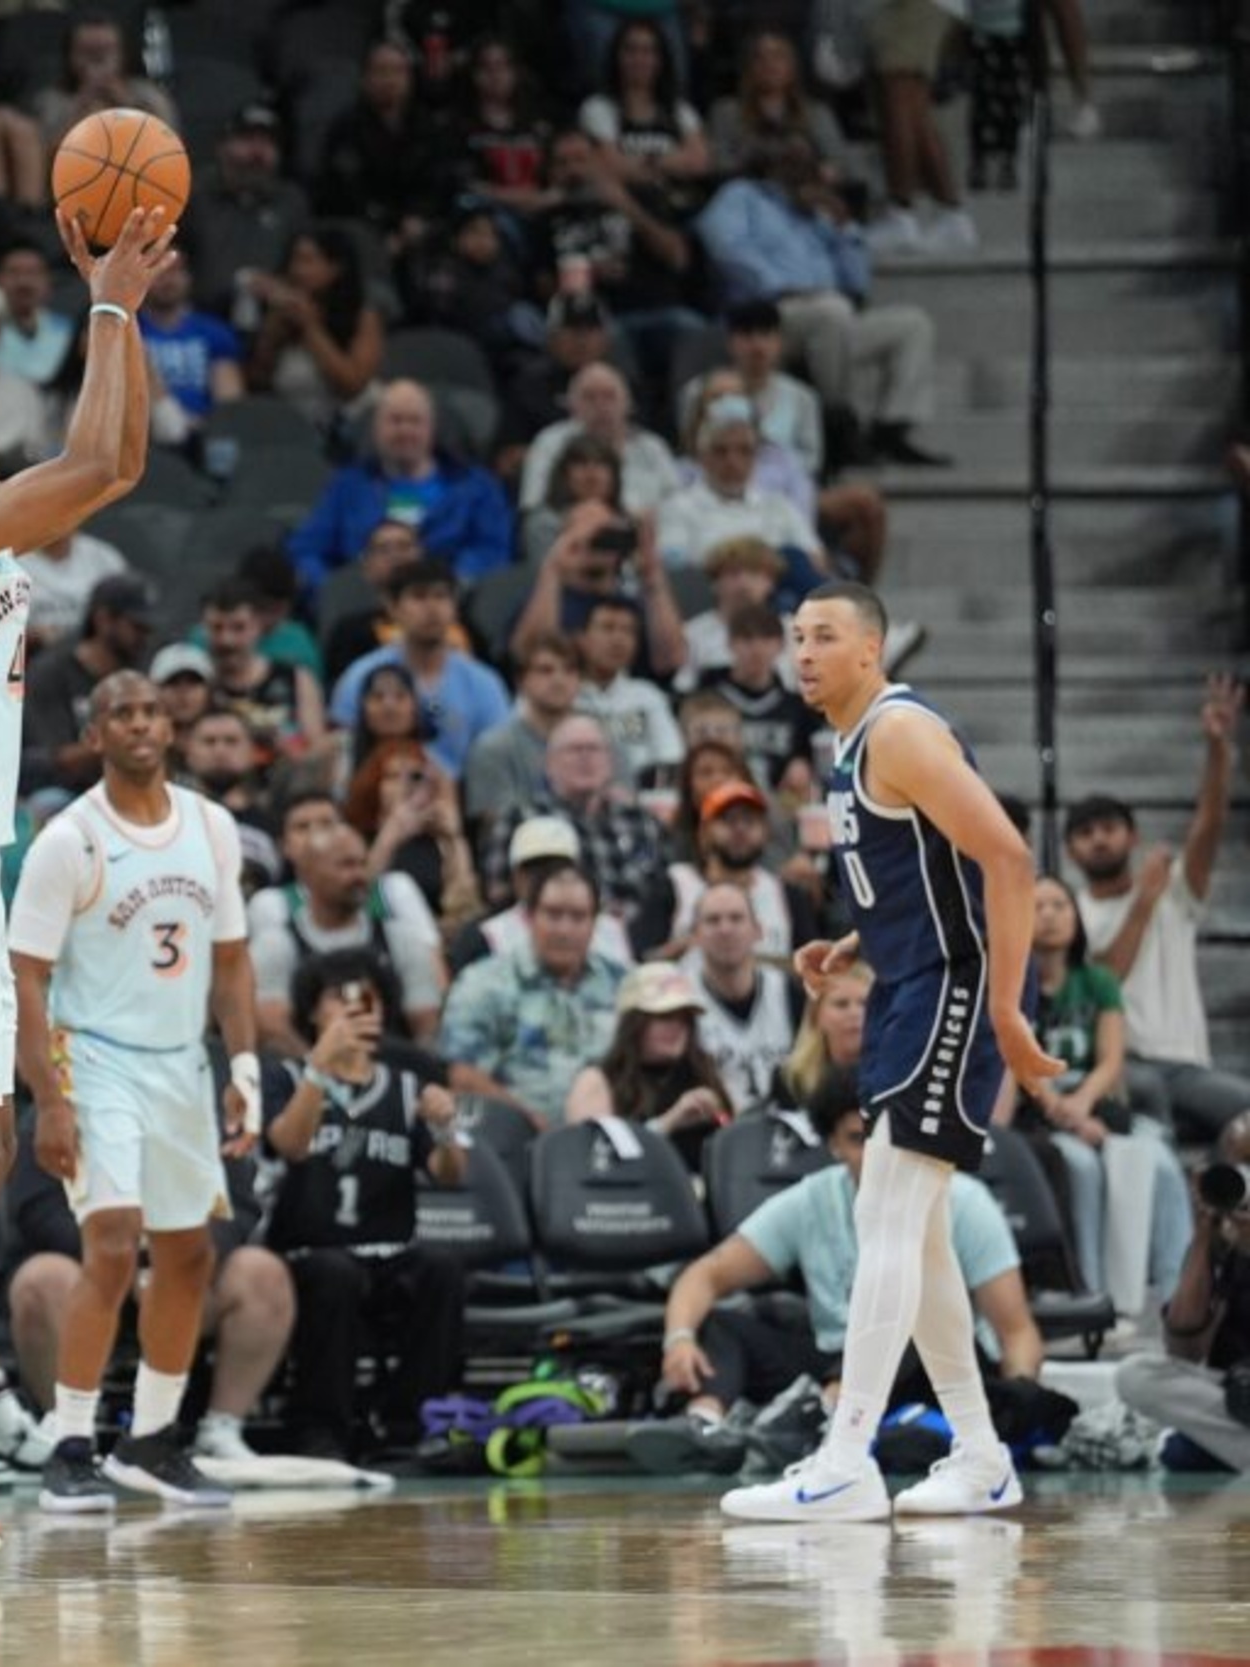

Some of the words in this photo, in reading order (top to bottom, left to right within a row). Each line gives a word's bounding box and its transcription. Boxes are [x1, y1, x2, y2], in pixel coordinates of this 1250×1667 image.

[843, 850, 876, 909] 0
[108, 887, 147, 931] SAN
[151, 921, 180, 970] 3
[335, 1175, 359, 1225] 1
